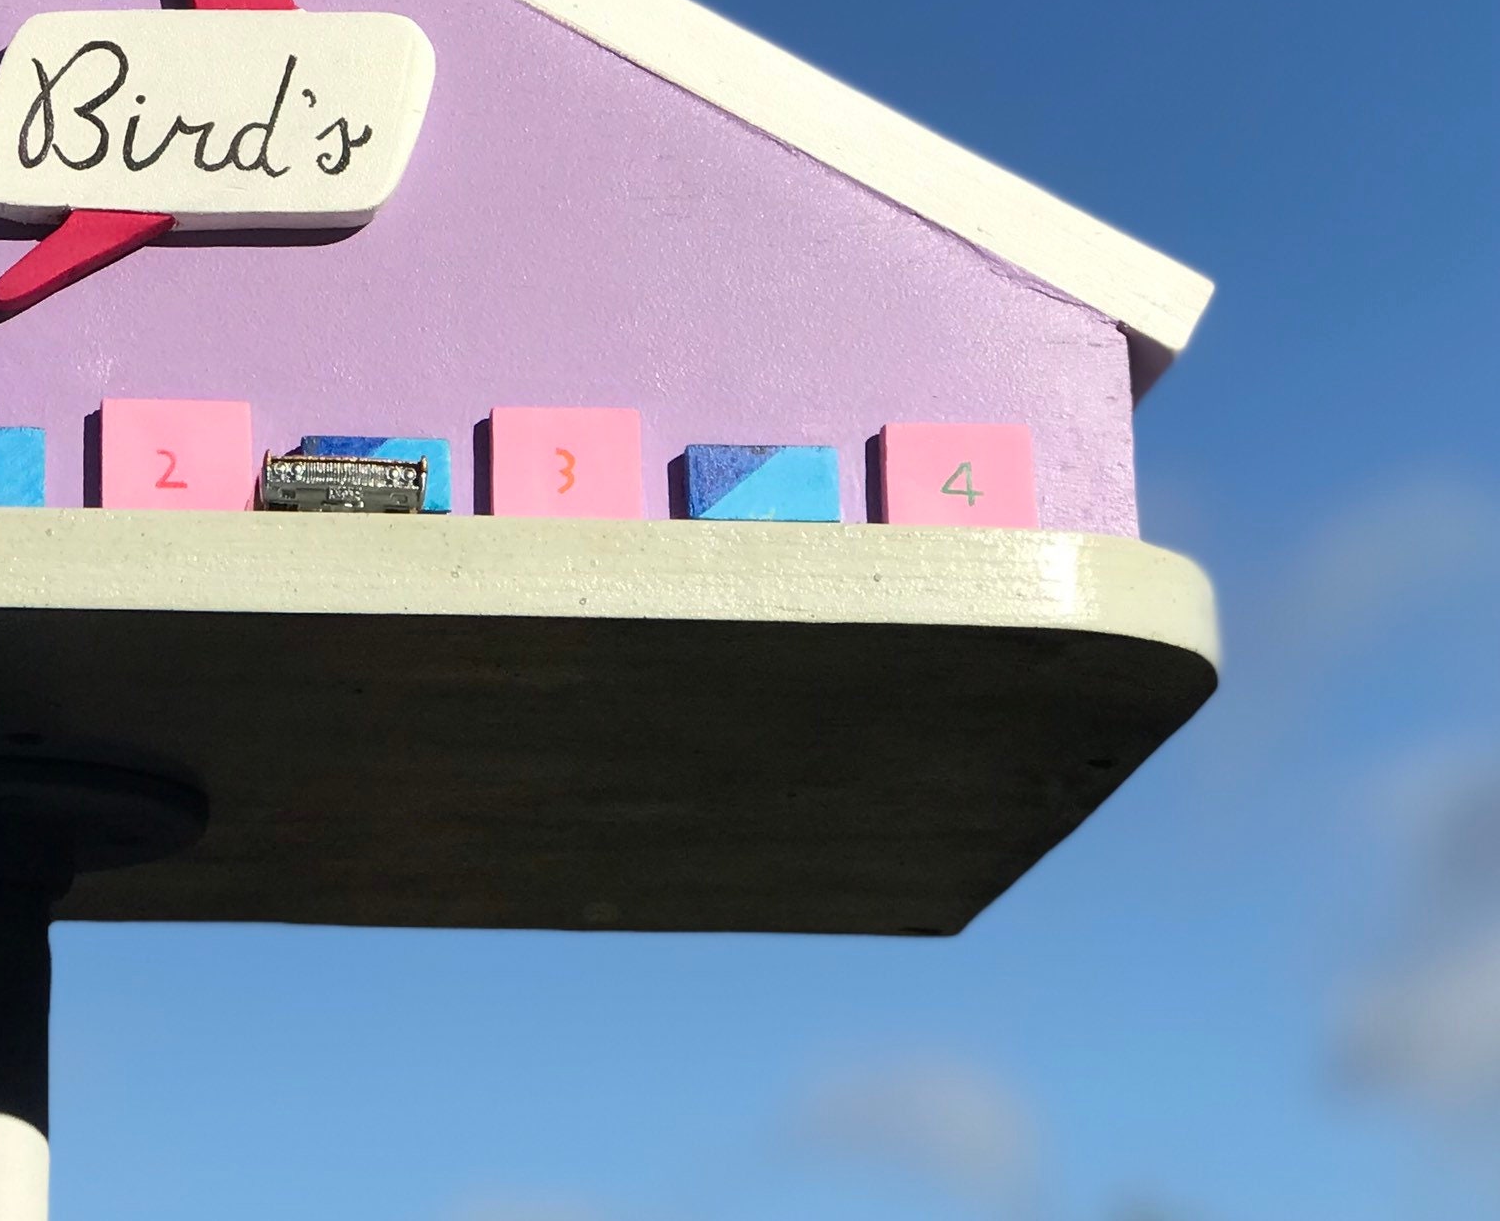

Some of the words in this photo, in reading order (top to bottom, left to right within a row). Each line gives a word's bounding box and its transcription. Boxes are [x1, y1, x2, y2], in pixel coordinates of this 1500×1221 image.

[18, 40, 372, 178] Bird's
[155, 449, 188, 489] 2
[555, 447, 576, 494] 3
[941, 461, 984, 507] 4
